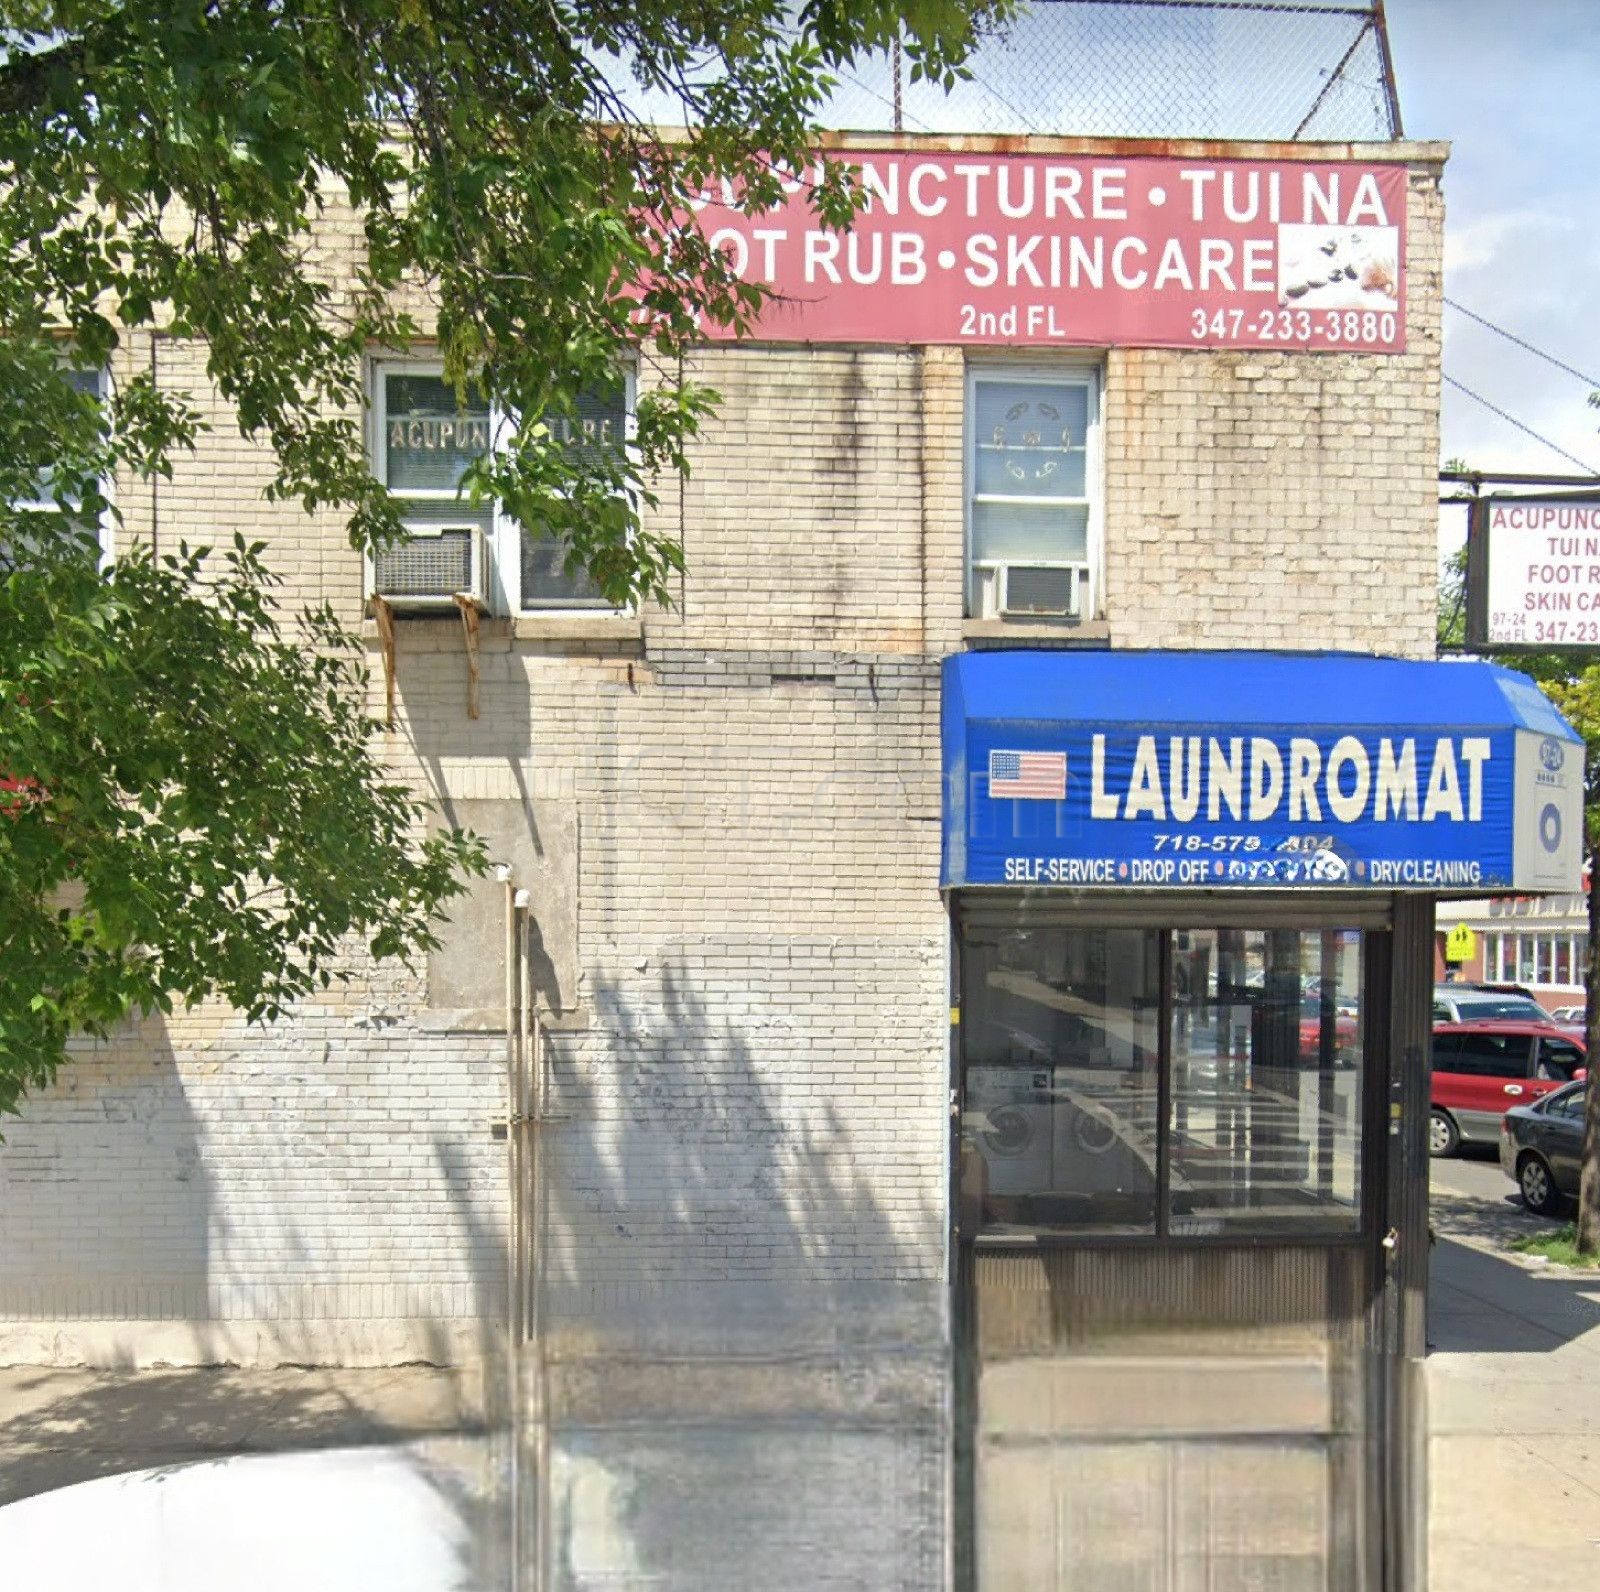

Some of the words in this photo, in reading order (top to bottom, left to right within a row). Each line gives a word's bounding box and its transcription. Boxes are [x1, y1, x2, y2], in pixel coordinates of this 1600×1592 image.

[1180, 170, 1280, 224] TUI
[1302, 172, 1389, 226] NA
[805, 232, 927, 285] RUB
[964, 233, 1276, 293] SKINCARE
[960, 304, 1017, 336] 2nd
[1027, 305, 1066, 336] FL
[1191, 309, 1396, 342] 347-233-3880
[390, 420, 487, 448] ACUPUN
[1492, 507, 1600, 529] ACUPUNC
[1547, 537, 1579, 556] TUI
[1528, 565, 1583, 583] FOOT
[1525, 592, 1571, 611] SKIN
[1492, 612, 1526, 626] 97-24
[1091, 734, 1491, 824] LAUNDROMAT
[1004, 857, 1116, 882] SELF-SERVICE
[1131, 859, 1176, 882] DROP
[1179, 859, 1210, 882] OFF
